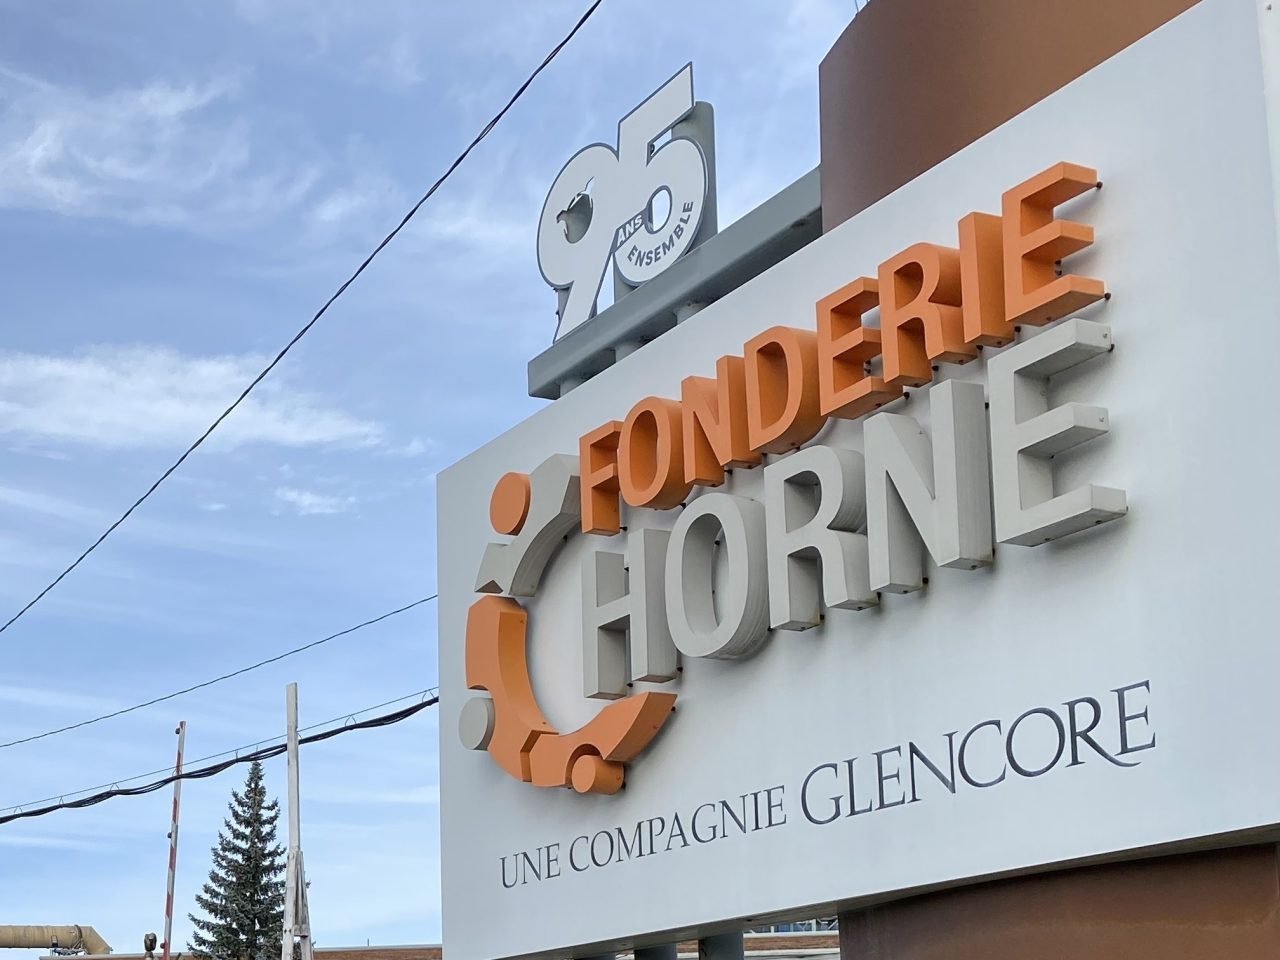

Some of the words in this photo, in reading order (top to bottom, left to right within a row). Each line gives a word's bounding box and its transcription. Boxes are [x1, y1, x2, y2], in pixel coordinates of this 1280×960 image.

[616, 214, 644, 247] ANS
[627, 200, 695, 268] ENSEMBLE
[579, 161, 1106, 537] FONDERIE
[581, 317, 1128, 700] HORNE
[499, 842, 562, 889] UNE
[568, 785, 788, 873] COMPAGNIE
[800, 680, 1158, 825] GLENCORE
